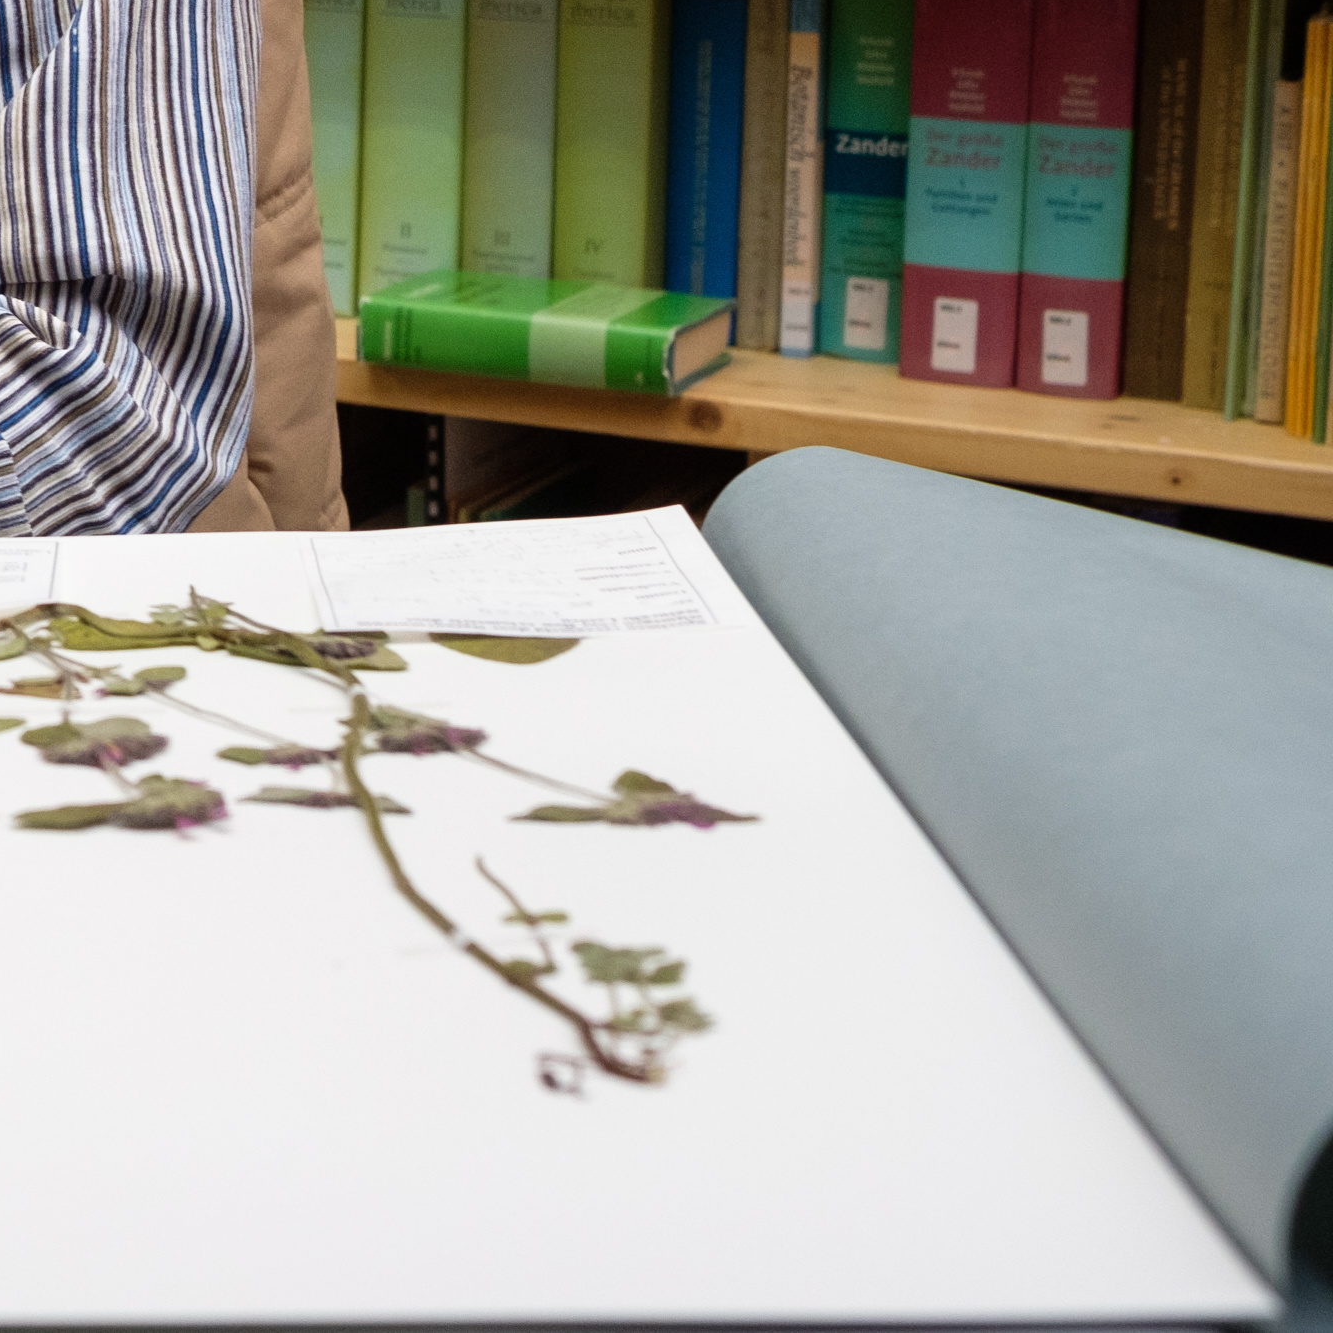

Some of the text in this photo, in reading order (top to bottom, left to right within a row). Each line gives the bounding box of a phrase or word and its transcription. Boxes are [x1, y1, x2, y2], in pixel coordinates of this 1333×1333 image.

[835, 133, 908, 158] Zander
[924, 147, 1002, 172] Zander
[1037, 153, 1116, 179] Zander
